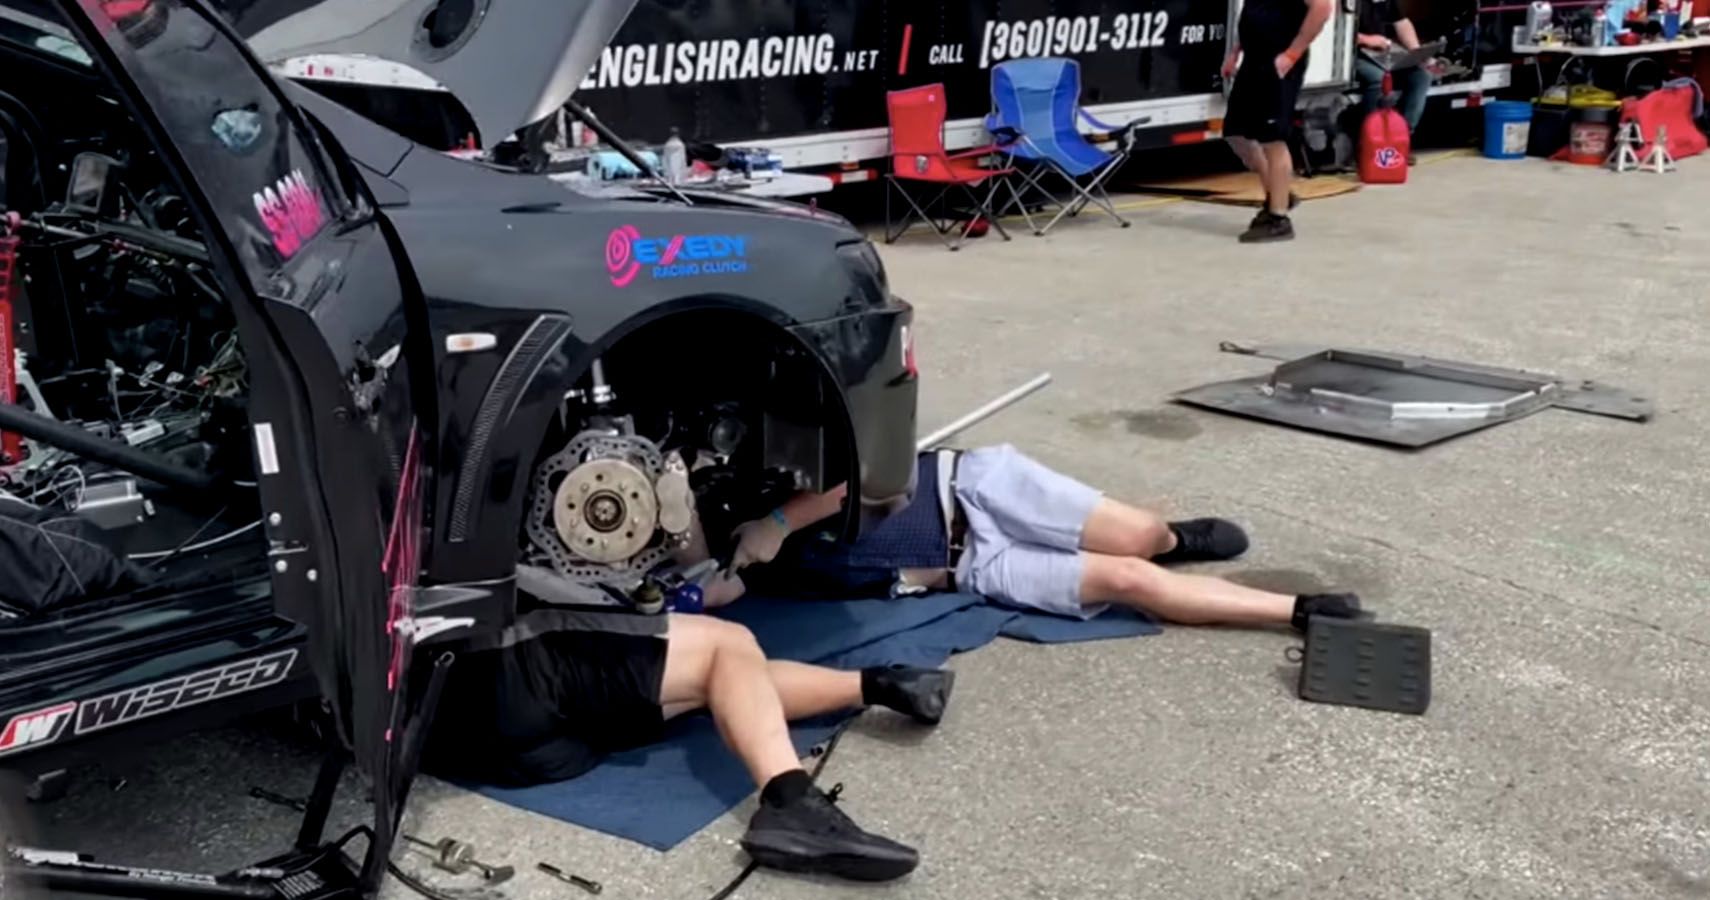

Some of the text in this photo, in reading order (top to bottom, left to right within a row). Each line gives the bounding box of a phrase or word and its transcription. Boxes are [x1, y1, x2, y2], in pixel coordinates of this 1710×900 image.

[929, 44, 963, 65] CALL
[1180, 24, 1205, 44] FOR
[633, 233, 749, 264] EXEDY
